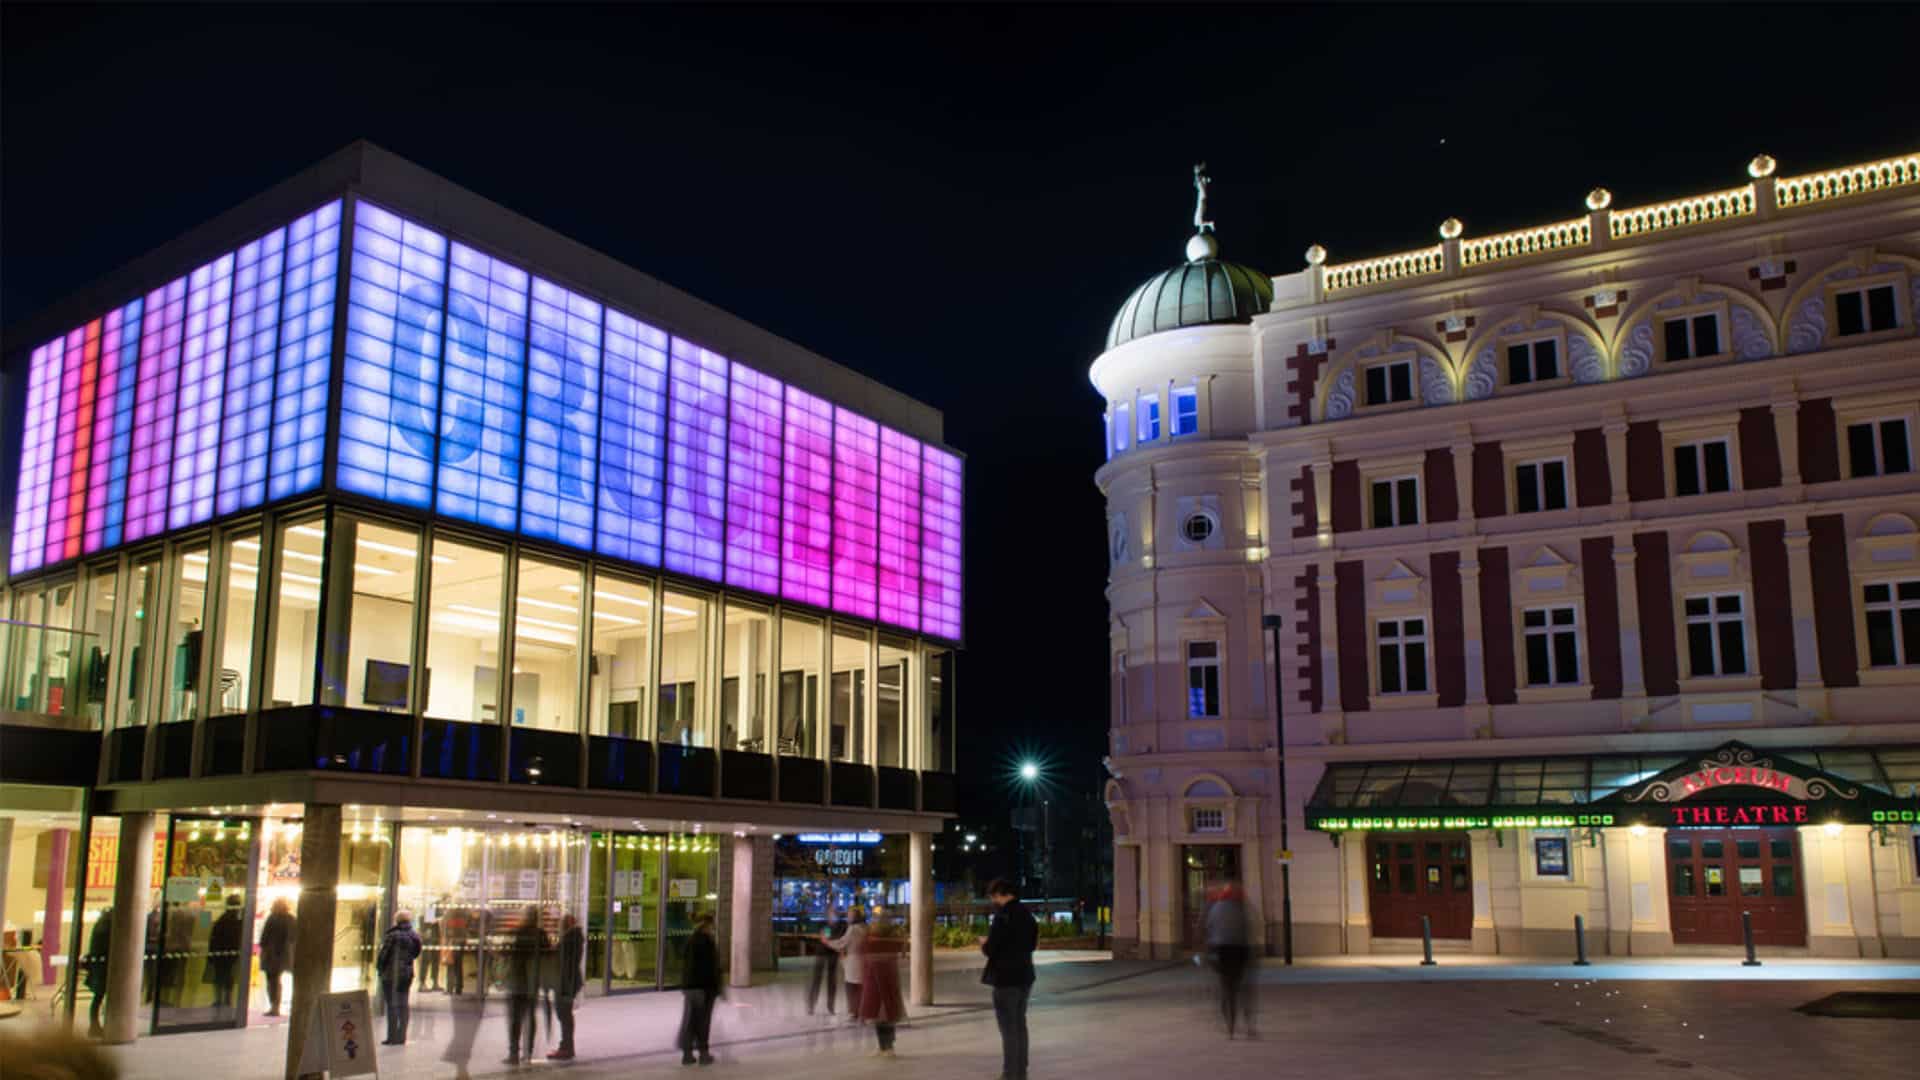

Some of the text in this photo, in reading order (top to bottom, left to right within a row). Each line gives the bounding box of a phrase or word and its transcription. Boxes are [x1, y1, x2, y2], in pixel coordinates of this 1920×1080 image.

[391, 283, 943, 601] CRUCIBLE
[1683, 767, 1792, 793] LYCEUM
[1671, 805, 1809, 824] THEATRE
